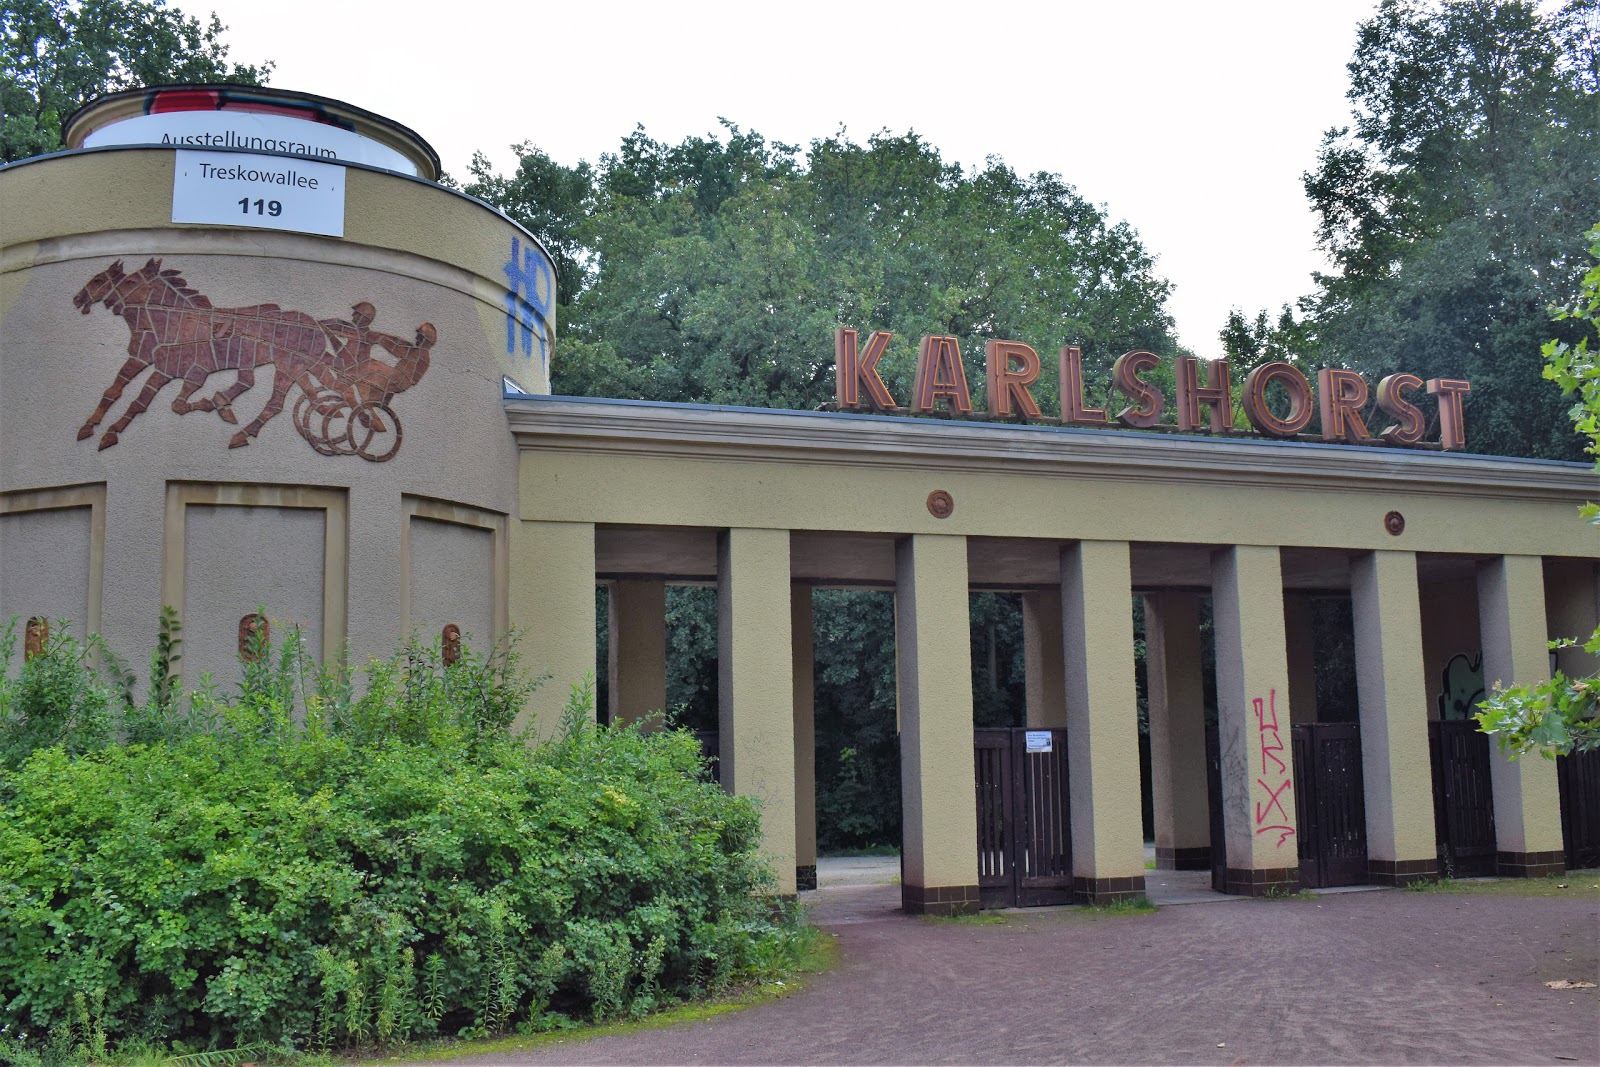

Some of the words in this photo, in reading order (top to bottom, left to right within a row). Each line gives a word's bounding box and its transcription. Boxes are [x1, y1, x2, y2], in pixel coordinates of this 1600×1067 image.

[199, 162, 319, 190] Treskowallee
[237, 197, 283, 217] 119
[834, 326, 1471, 450] KARLSHORST
